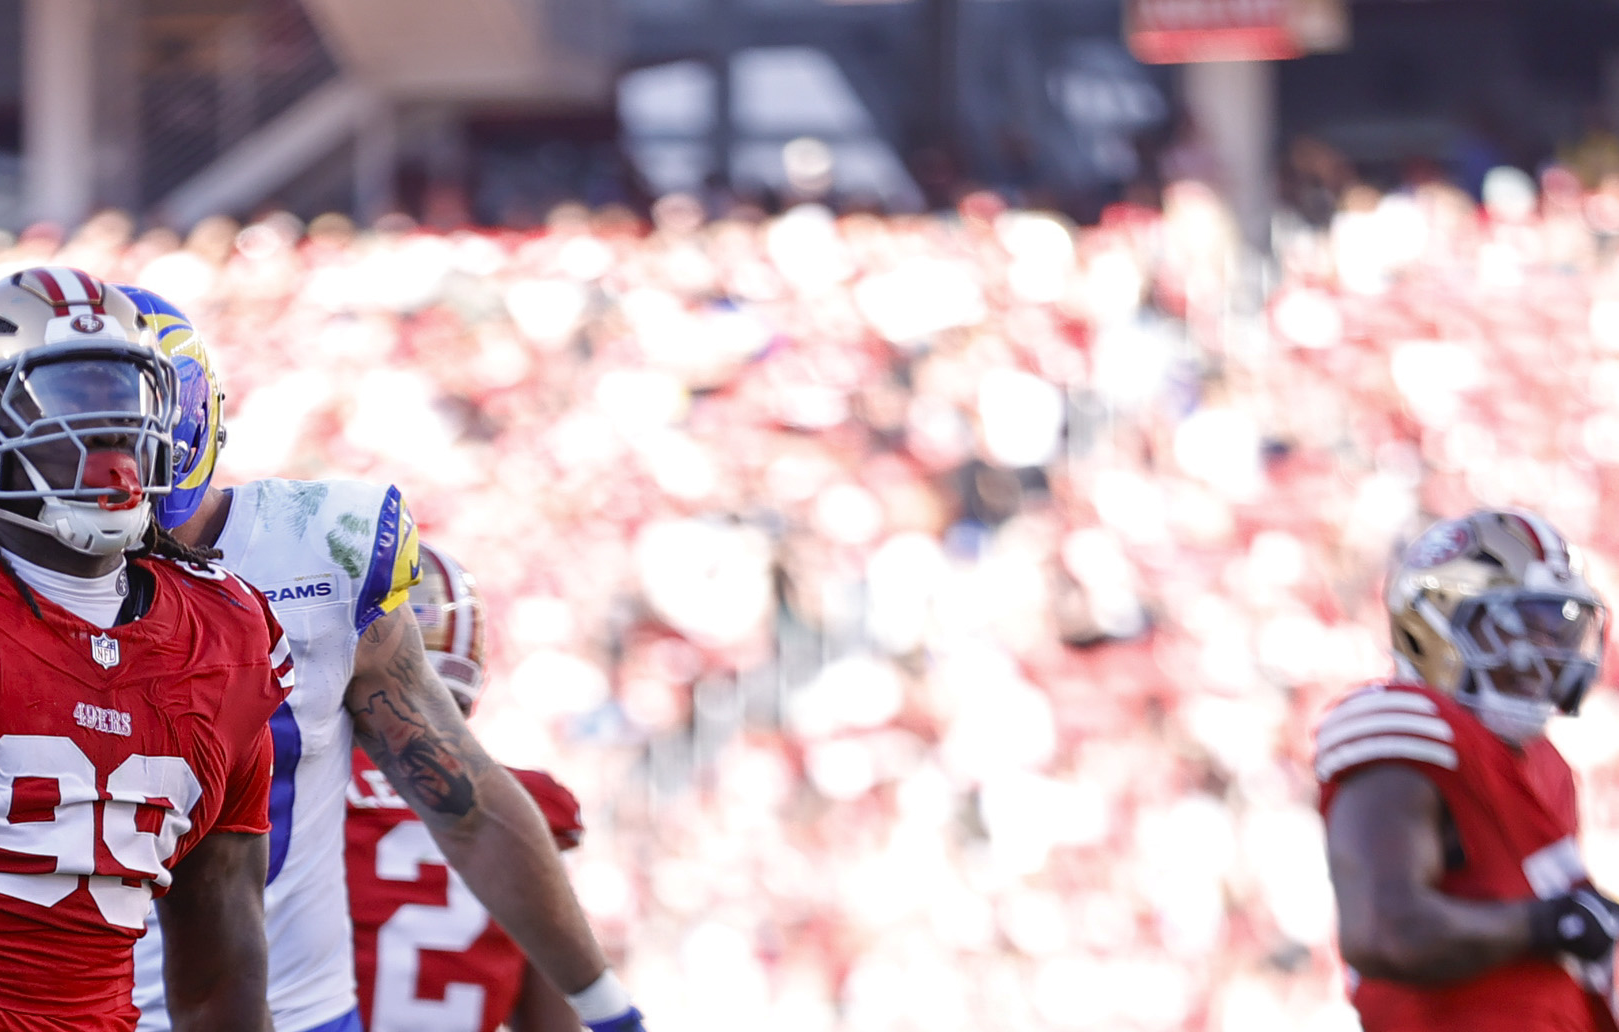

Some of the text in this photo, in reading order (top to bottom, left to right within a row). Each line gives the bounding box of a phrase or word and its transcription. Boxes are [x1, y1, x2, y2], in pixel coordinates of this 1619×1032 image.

[262, 582, 332, 602] RAMS
[96, 647, 116, 662] NFL
[72, 702, 132, 737] 49ERS
[346, 769, 411, 809] LE
